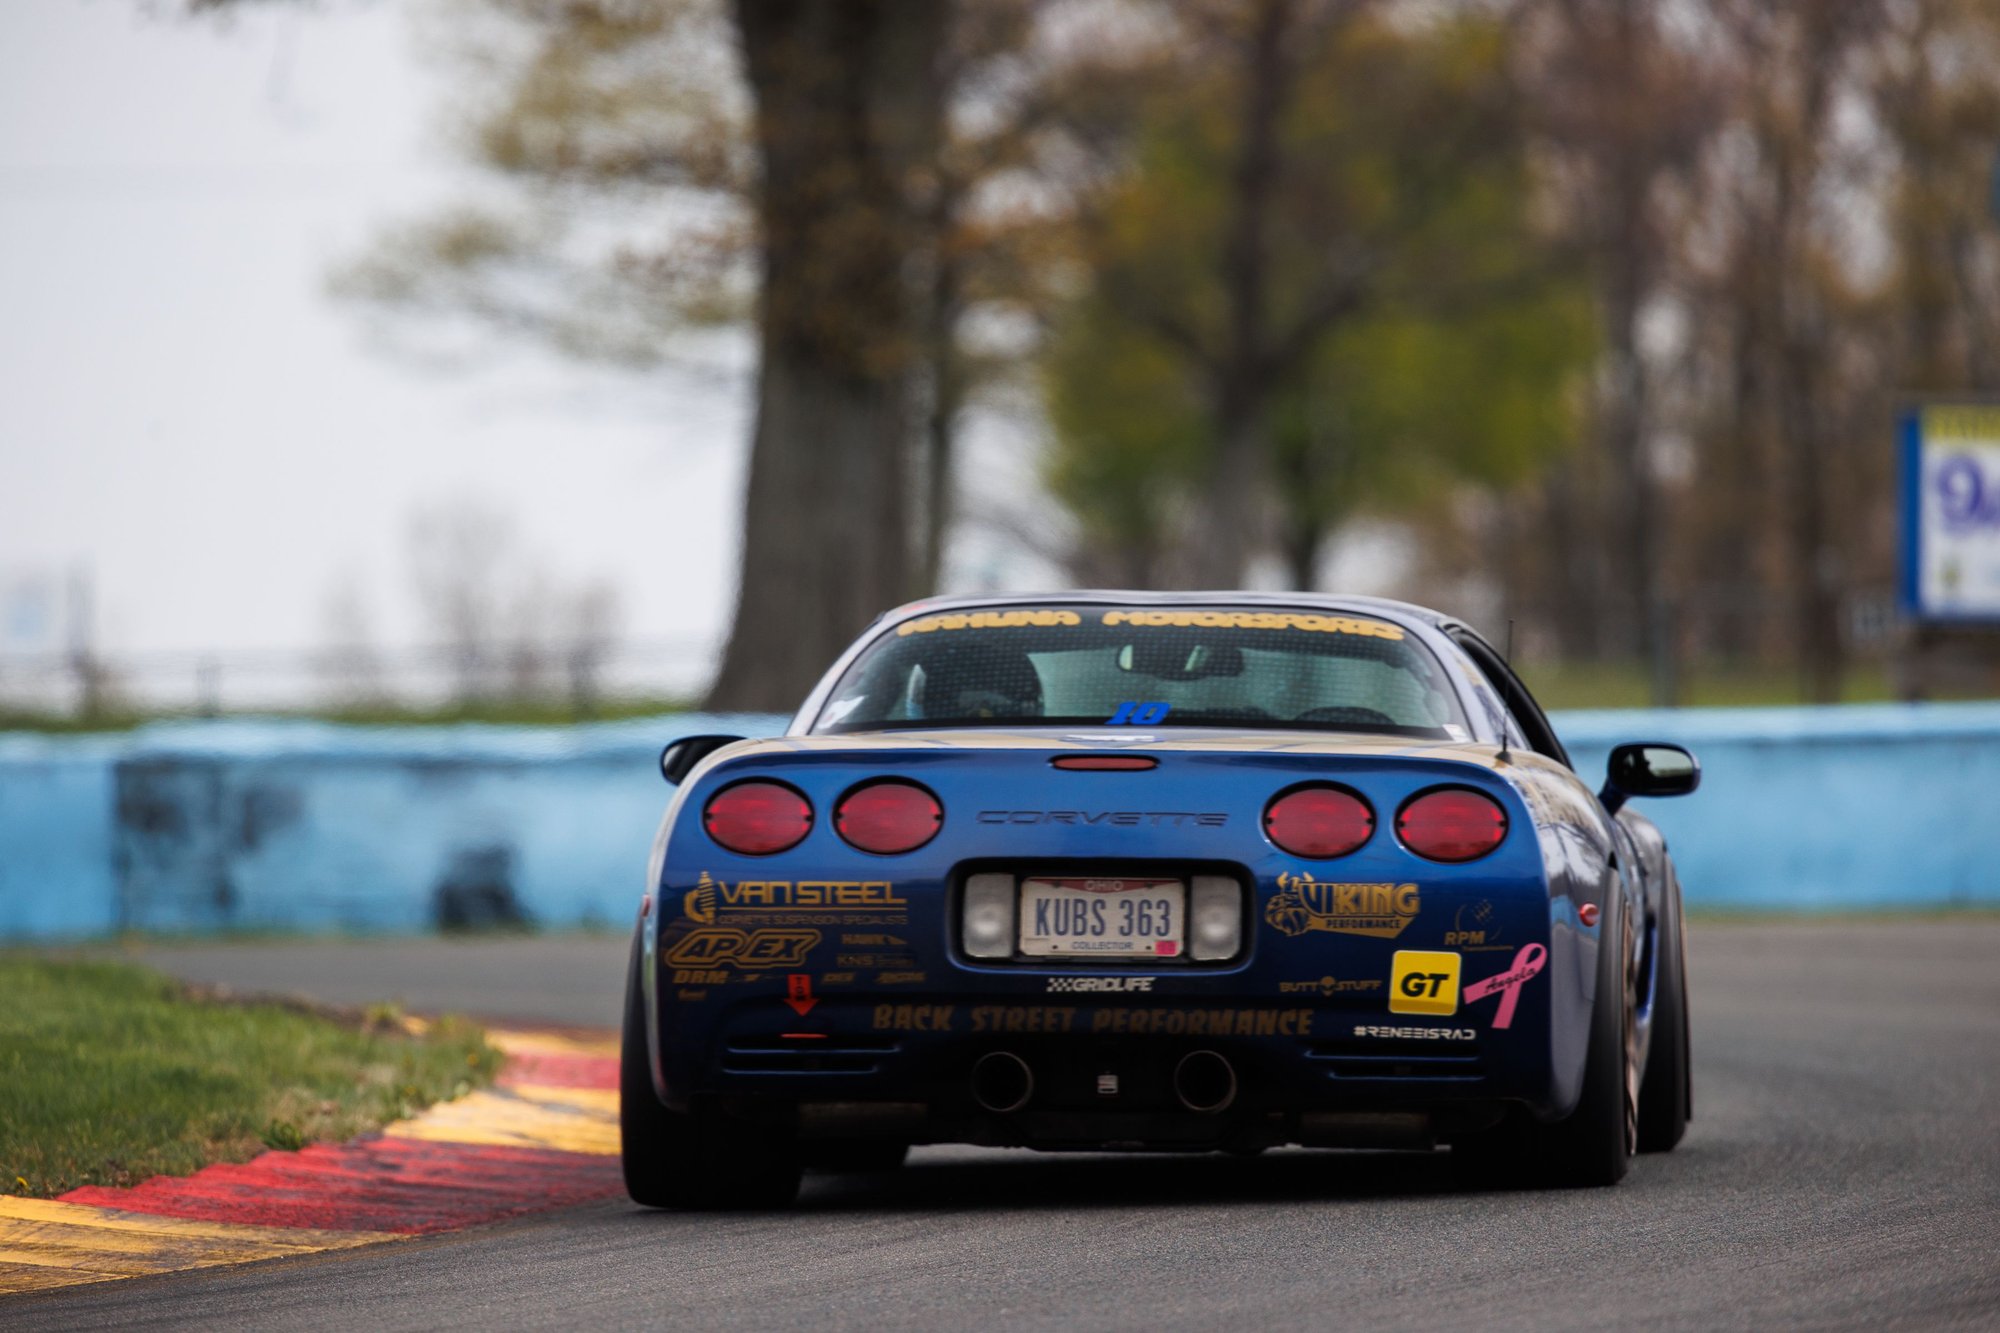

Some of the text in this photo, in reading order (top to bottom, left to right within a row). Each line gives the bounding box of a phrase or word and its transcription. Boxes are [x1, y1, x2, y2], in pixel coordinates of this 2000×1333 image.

[1102, 610, 1404, 640] MOTORSPORTS
[1105, 702, 1170, 724] 10
[976, 810, 1229, 827] CORVETTE
[719, 881, 908, 904] VAN STEEL
[1084, 880, 1123, 892] OHIO
[1299, 882, 1420, 917] VIKING
[1035, 898, 1171, 937] KUBS 363
[673, 933, 812, 962] APEX
[1071, 940, 1134, 950] COLLECTOR
[1444, 931, 1486, 946] RPM
[1072, 977, 1156, 992] GRIDLIFE
[1400, 972, 1450, 998] GT
[1483, 966, 1537, 994] Angela
[873, 1004, 1314, 1035] BACK STREET PERFORMANCE
[1354, 1026, 1477, 1040] #RENEEISRAD
